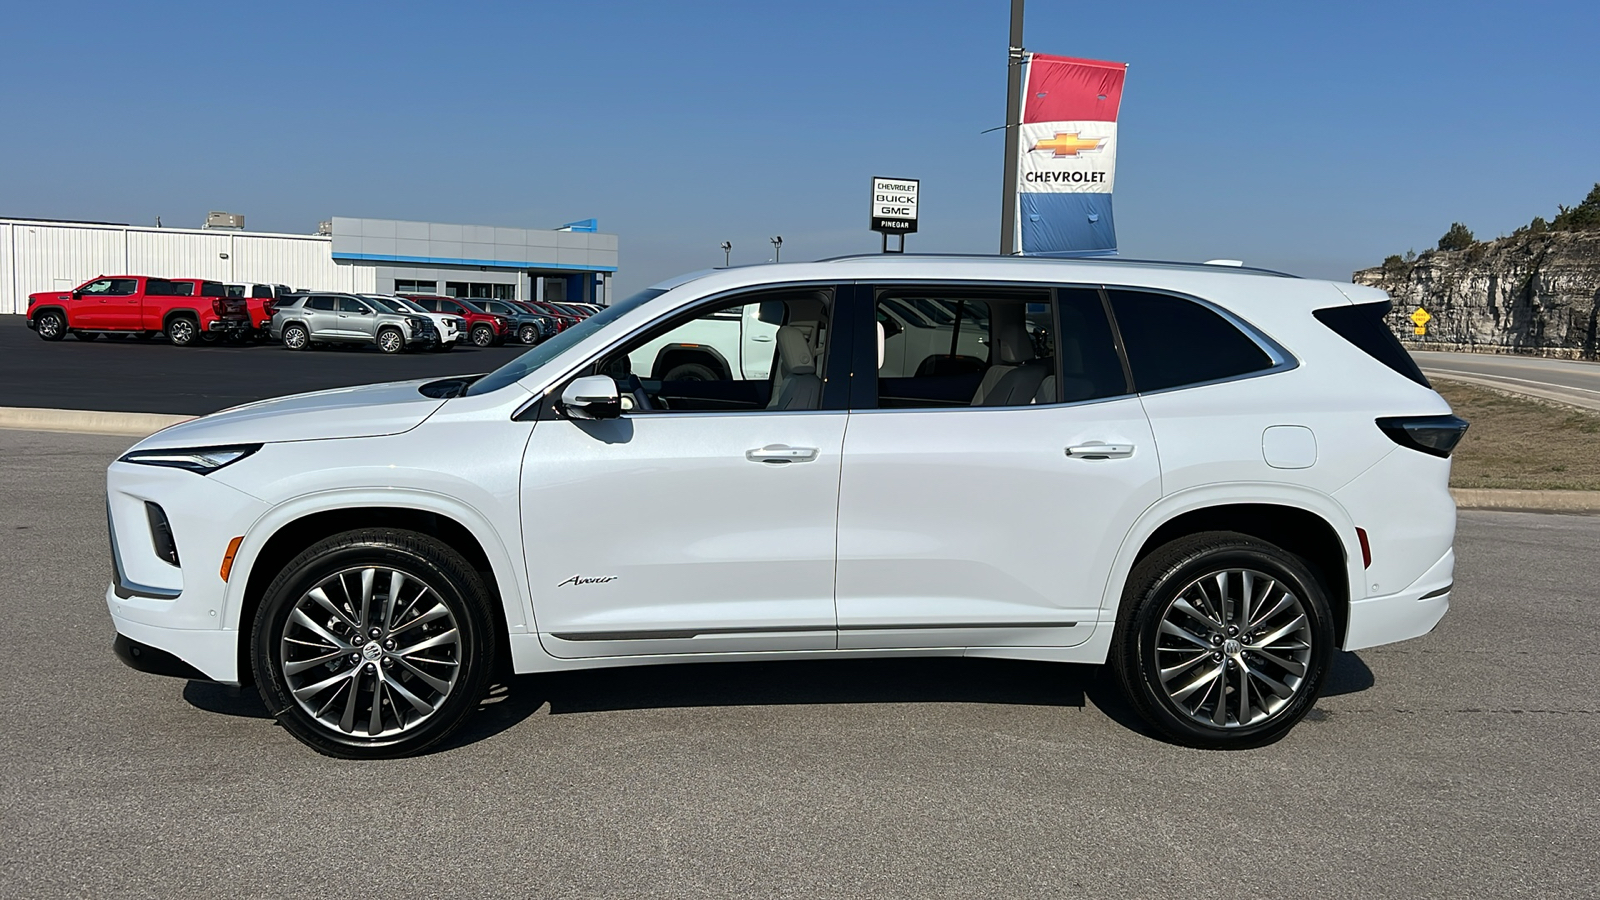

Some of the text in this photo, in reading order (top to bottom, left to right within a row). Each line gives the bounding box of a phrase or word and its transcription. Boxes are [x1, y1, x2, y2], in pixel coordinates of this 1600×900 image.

[1026, 171, 1105, 182] CHEVROLET
[877, 183, 916, 192] CHEVROLET
[876, 194, 915, 204] BUICK
[881, 206, 910, 215] GMC
[881, 220, 909, 229] PINEGAR
[557, 575, 618, 588] Avenir
